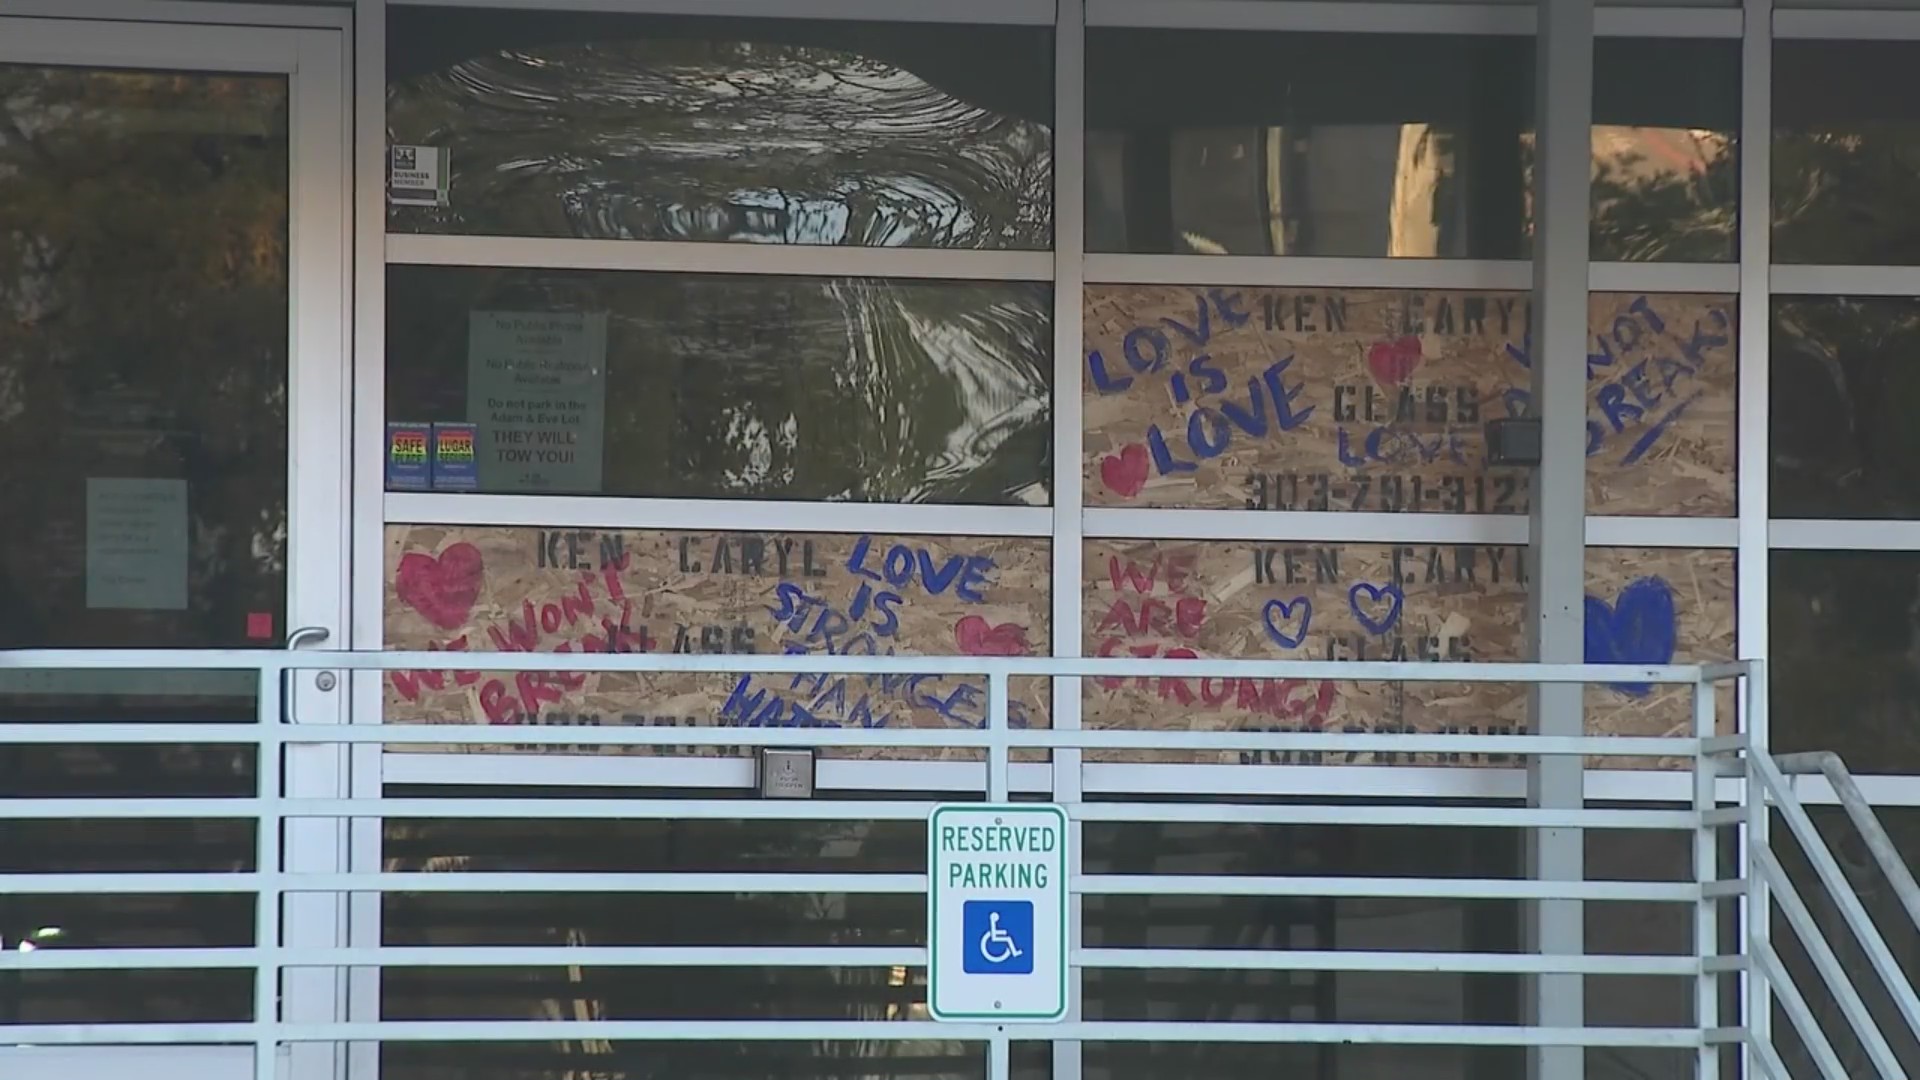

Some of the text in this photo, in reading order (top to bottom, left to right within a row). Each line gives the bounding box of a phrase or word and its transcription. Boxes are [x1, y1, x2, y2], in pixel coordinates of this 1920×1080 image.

[1262, 294, 1530, 336] KEN CARY
[1088, 287, 1250, 394] LOVE
[1171, 354, 1228, 403] IS
[488, 398, 586, 411] Do not park in the
[491, 412, 579, 425] Adam & Eve Lot
[1148, 354, 1316, 475] LOVE
[396, 438, 423, 453] SAFE
[440, 439, 471, 453] LUGAR
[492, 430, 576, 445] THEY WILL
[497, 449, 575, 464] TOW YOU!
[537, 531, 827, 577] KEN CARYL
[847, 534, 1000, 601] LOVE
[1109, 551, 1199, 595] WE
[1254, 547, 1338, 584] KEN
[849, 581, 903, 637] IS
[1095, 596, 1208, 639] ARE
[942, 826, 1055, 852] RESERVED
[950, 863, 1048, 889] PARKING
